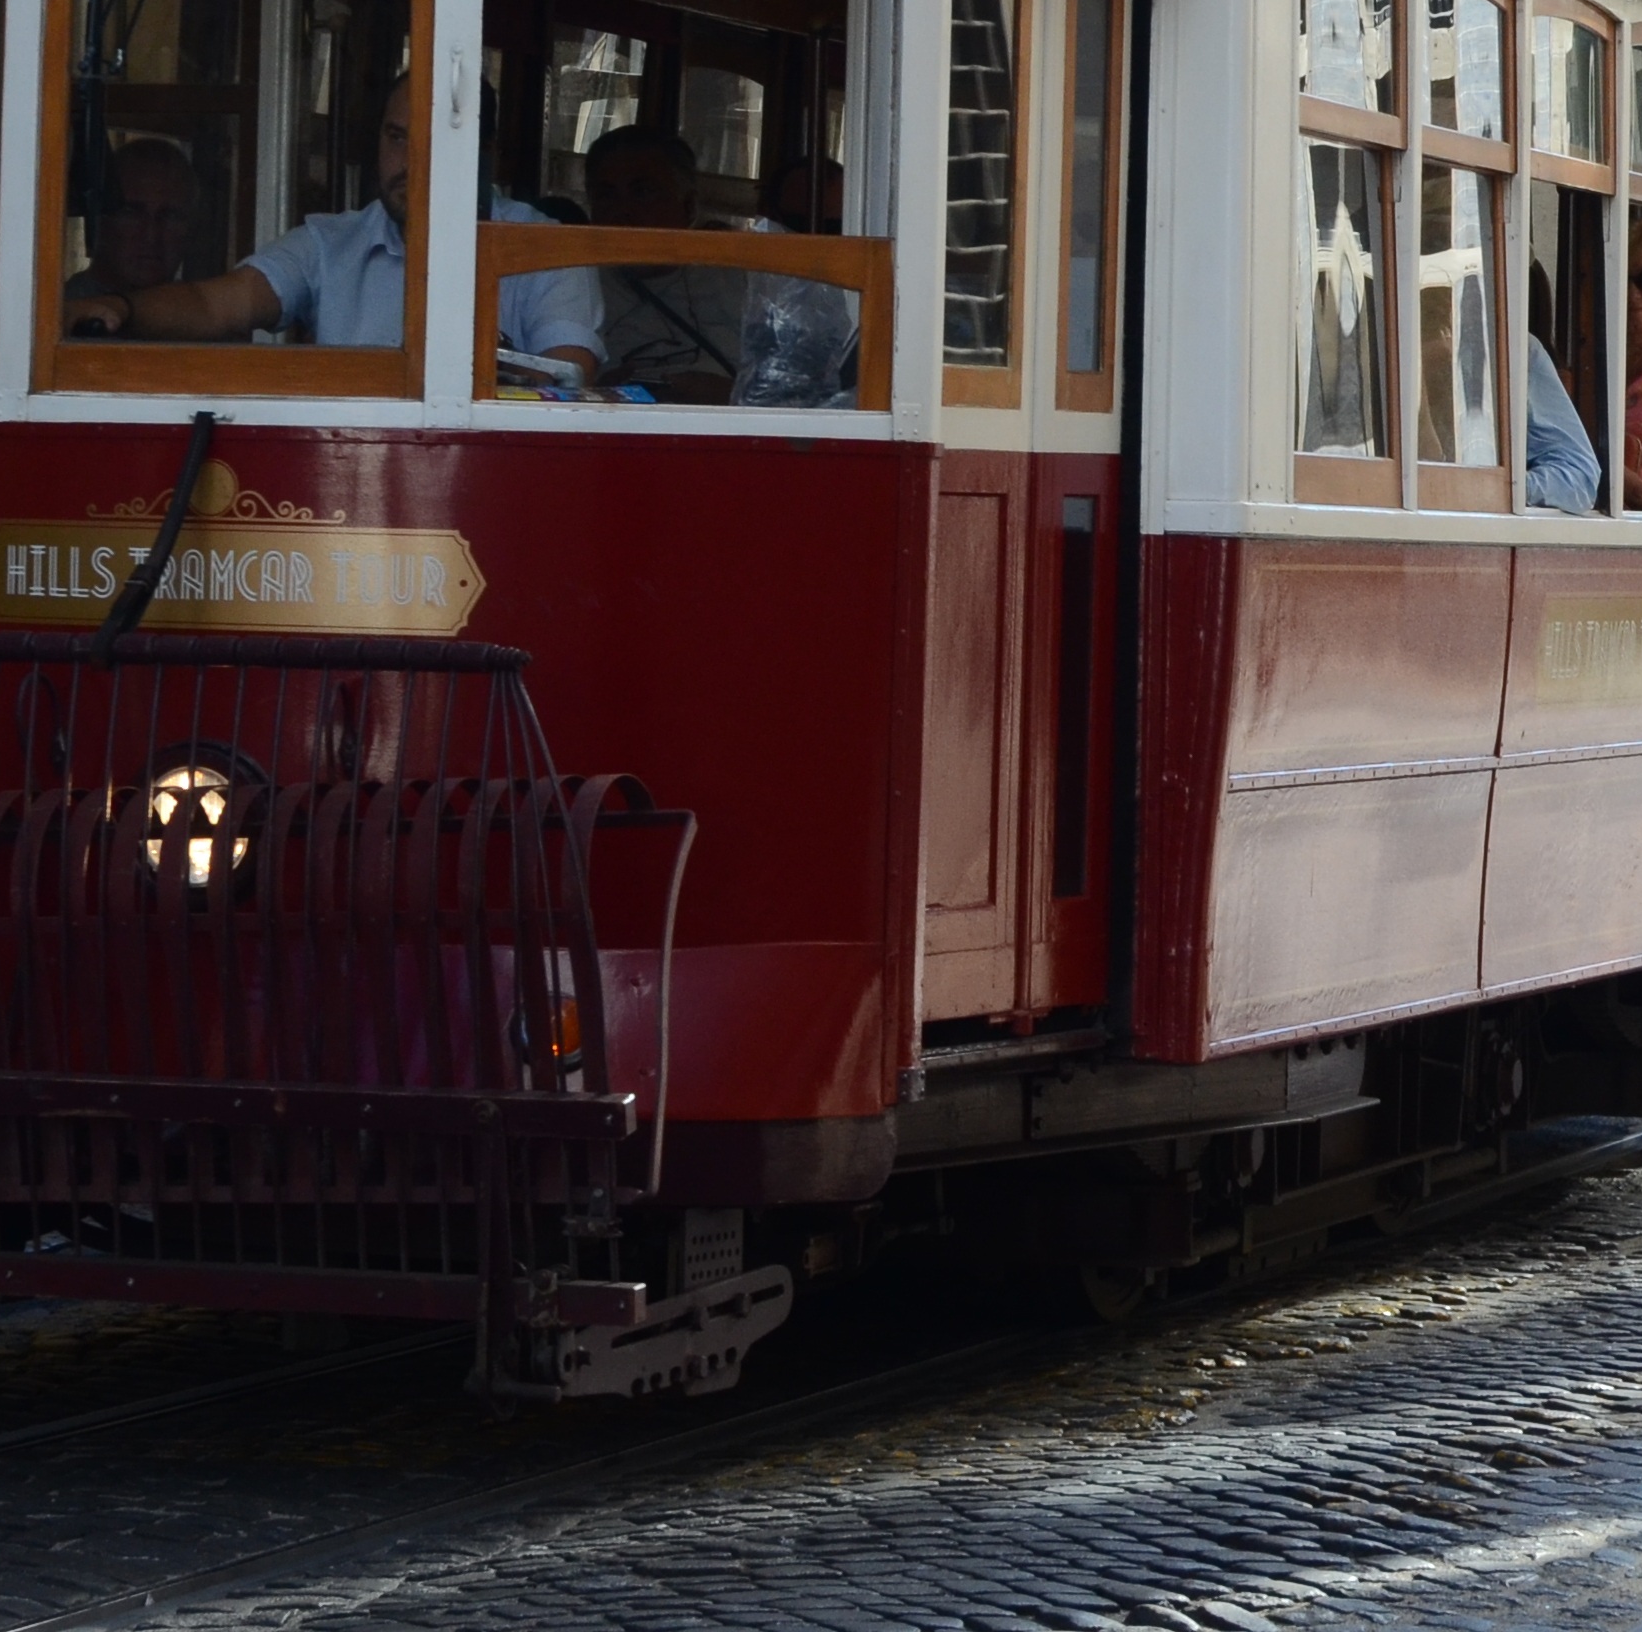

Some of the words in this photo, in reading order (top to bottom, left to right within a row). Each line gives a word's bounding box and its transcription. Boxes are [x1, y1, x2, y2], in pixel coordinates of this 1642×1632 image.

[7, 545, 116, 599] HILLS
[330, 551, 448, 607] TOUR
[1544, 620, 1582, 680] HILLS
